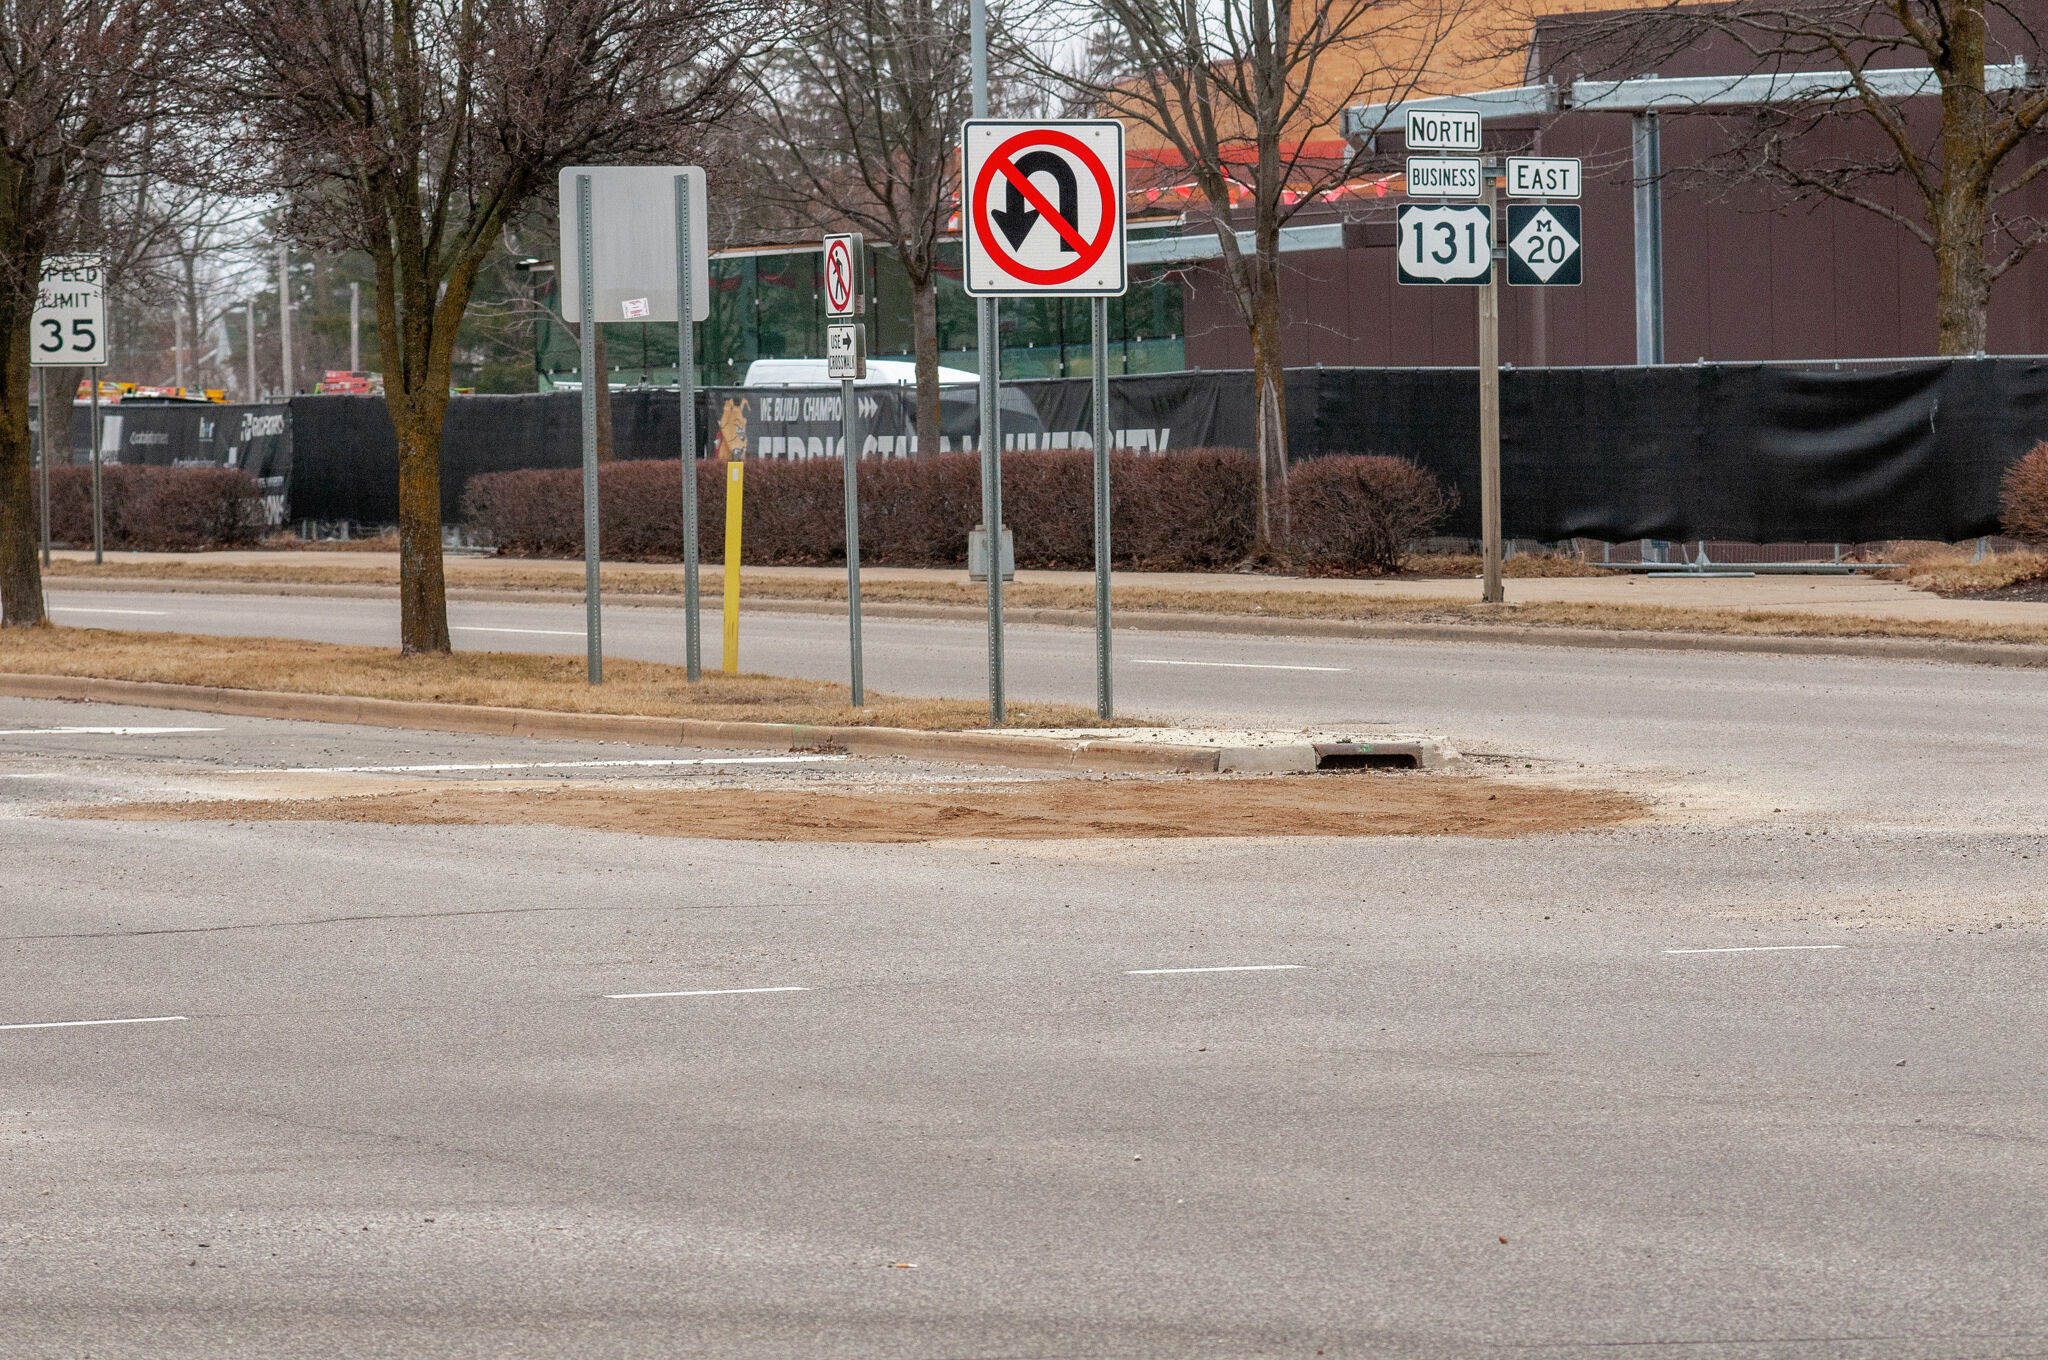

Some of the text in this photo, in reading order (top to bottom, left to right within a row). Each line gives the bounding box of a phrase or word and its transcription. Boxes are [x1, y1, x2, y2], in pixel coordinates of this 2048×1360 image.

[1412, 117, 1475, 142] NORTH
[1413, 168, 1476, 187] BUSINESS
[1517, 165, 1570, 190] EAST
[1536, 220, 1552, 232] M
[1413, 221, 1475, 264] 131
[1527, 235, 1565, 264] 20
[41, 266, 97, 282] PEED
[40, 319, 96, 352] 35
[830, 334, 841, 349] USE
[830, 355, 854, 369] CROSSWALK
[760, 396, 843, 421] WE BUILD CHAMPIO
